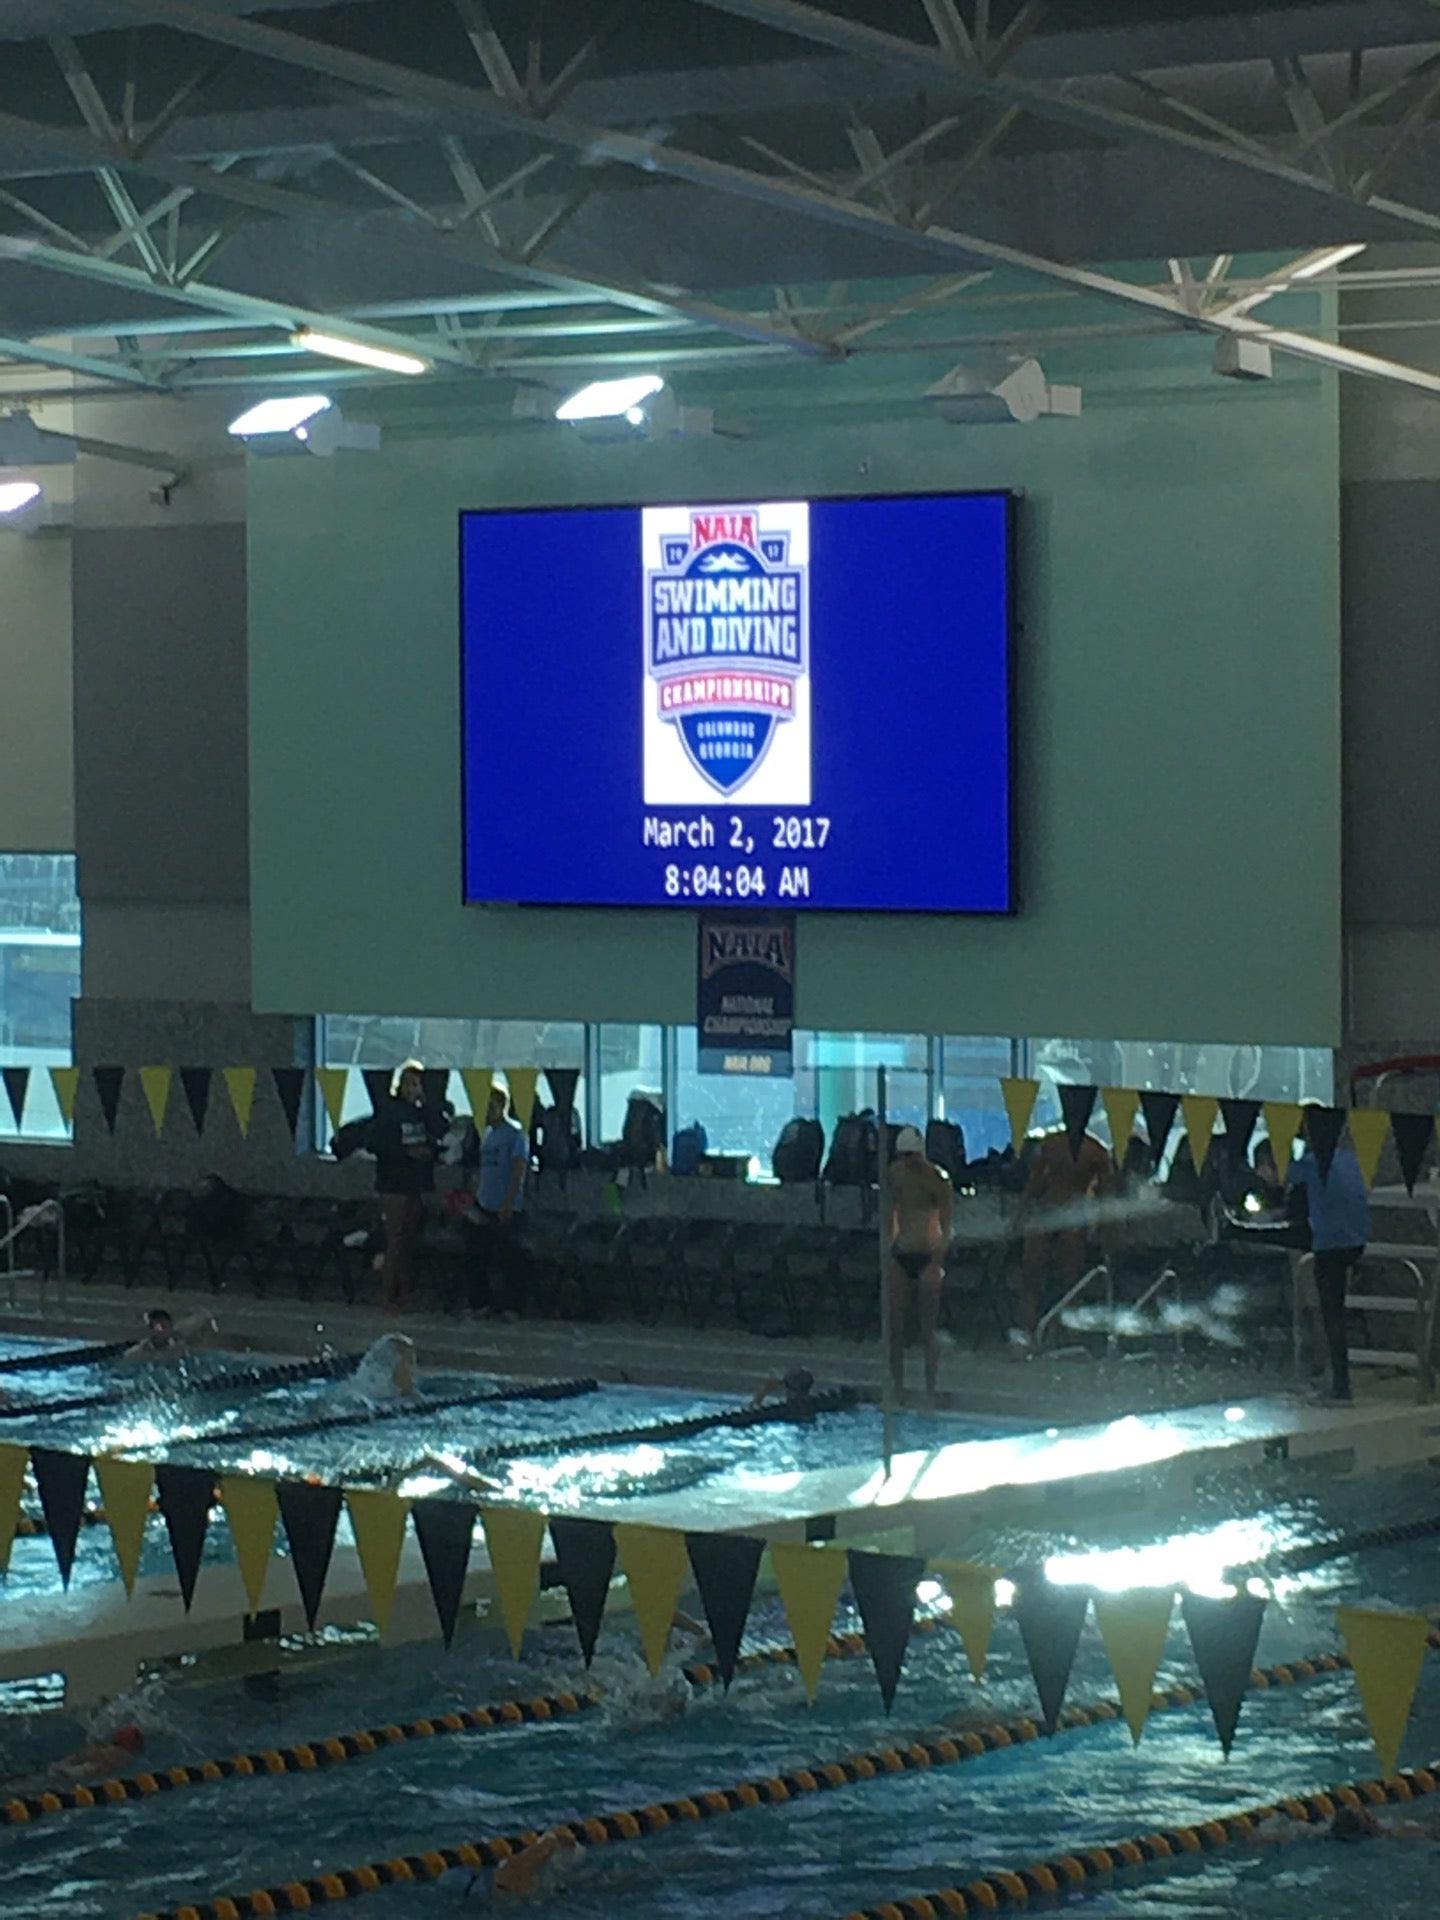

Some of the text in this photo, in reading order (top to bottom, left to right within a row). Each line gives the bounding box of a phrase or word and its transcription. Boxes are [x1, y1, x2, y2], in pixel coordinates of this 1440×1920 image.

[694, 516, 755, 549] NAIA
[654, 577, 797, 614] SWIMMING
[656, 615, 797, 660] AND DIVING
[663, 677, 790, 707] CHAMPIONSHIPS
[643, 815, 830, 854] March 2, 2017
[665, 864, 810, 897] 8:04:04 AM
[708, 930, 786, 966] NAIA
